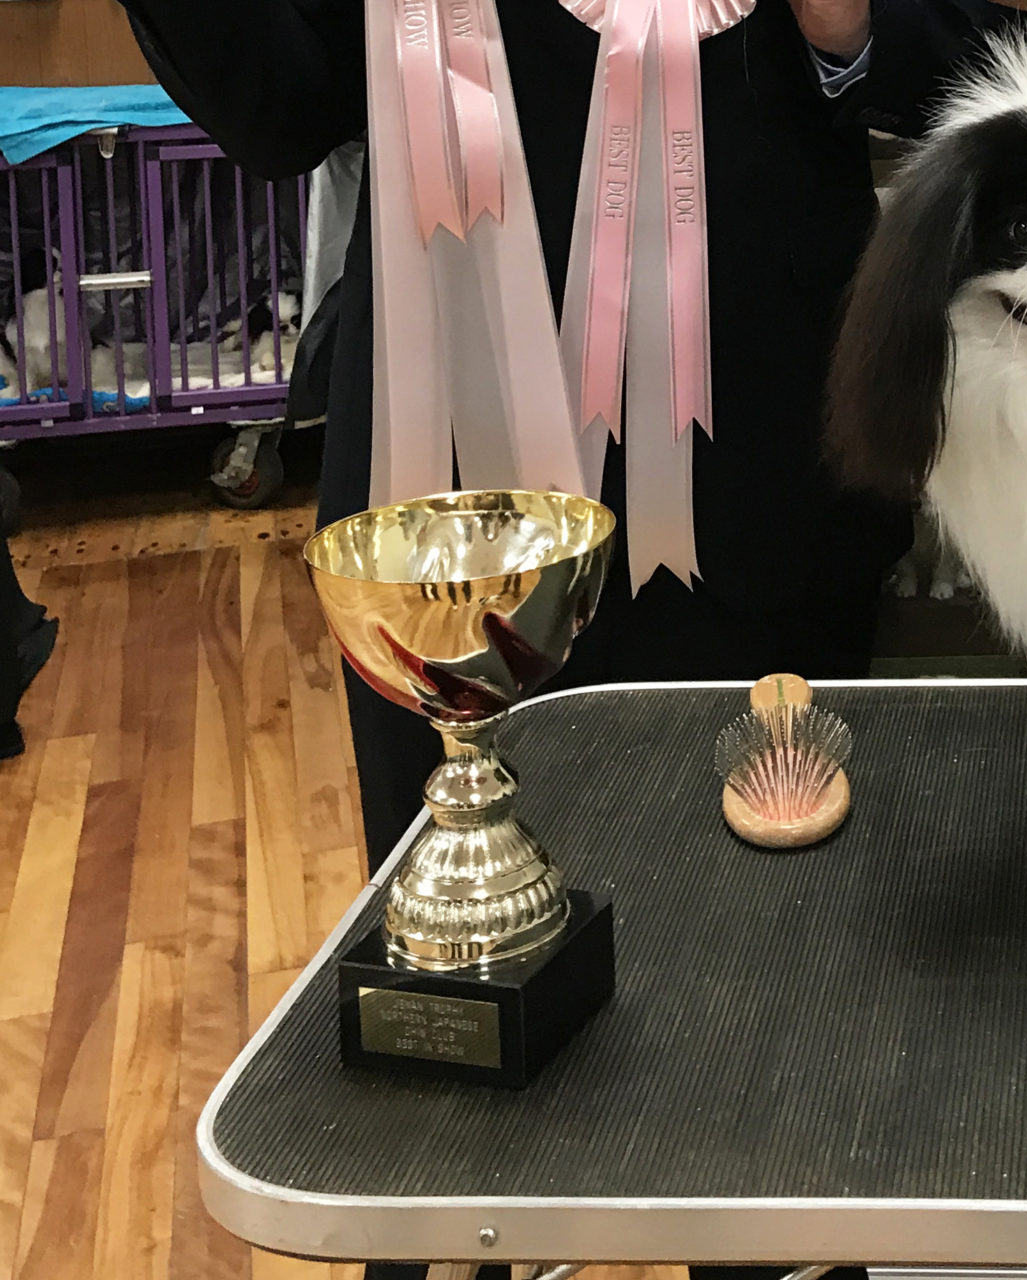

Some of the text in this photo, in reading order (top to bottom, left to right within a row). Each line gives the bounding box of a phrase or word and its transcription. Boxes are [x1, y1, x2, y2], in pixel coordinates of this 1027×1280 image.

[604, 125, 631, 219] BEST DOG
[671, 130, 697, 225] BEST DOG
